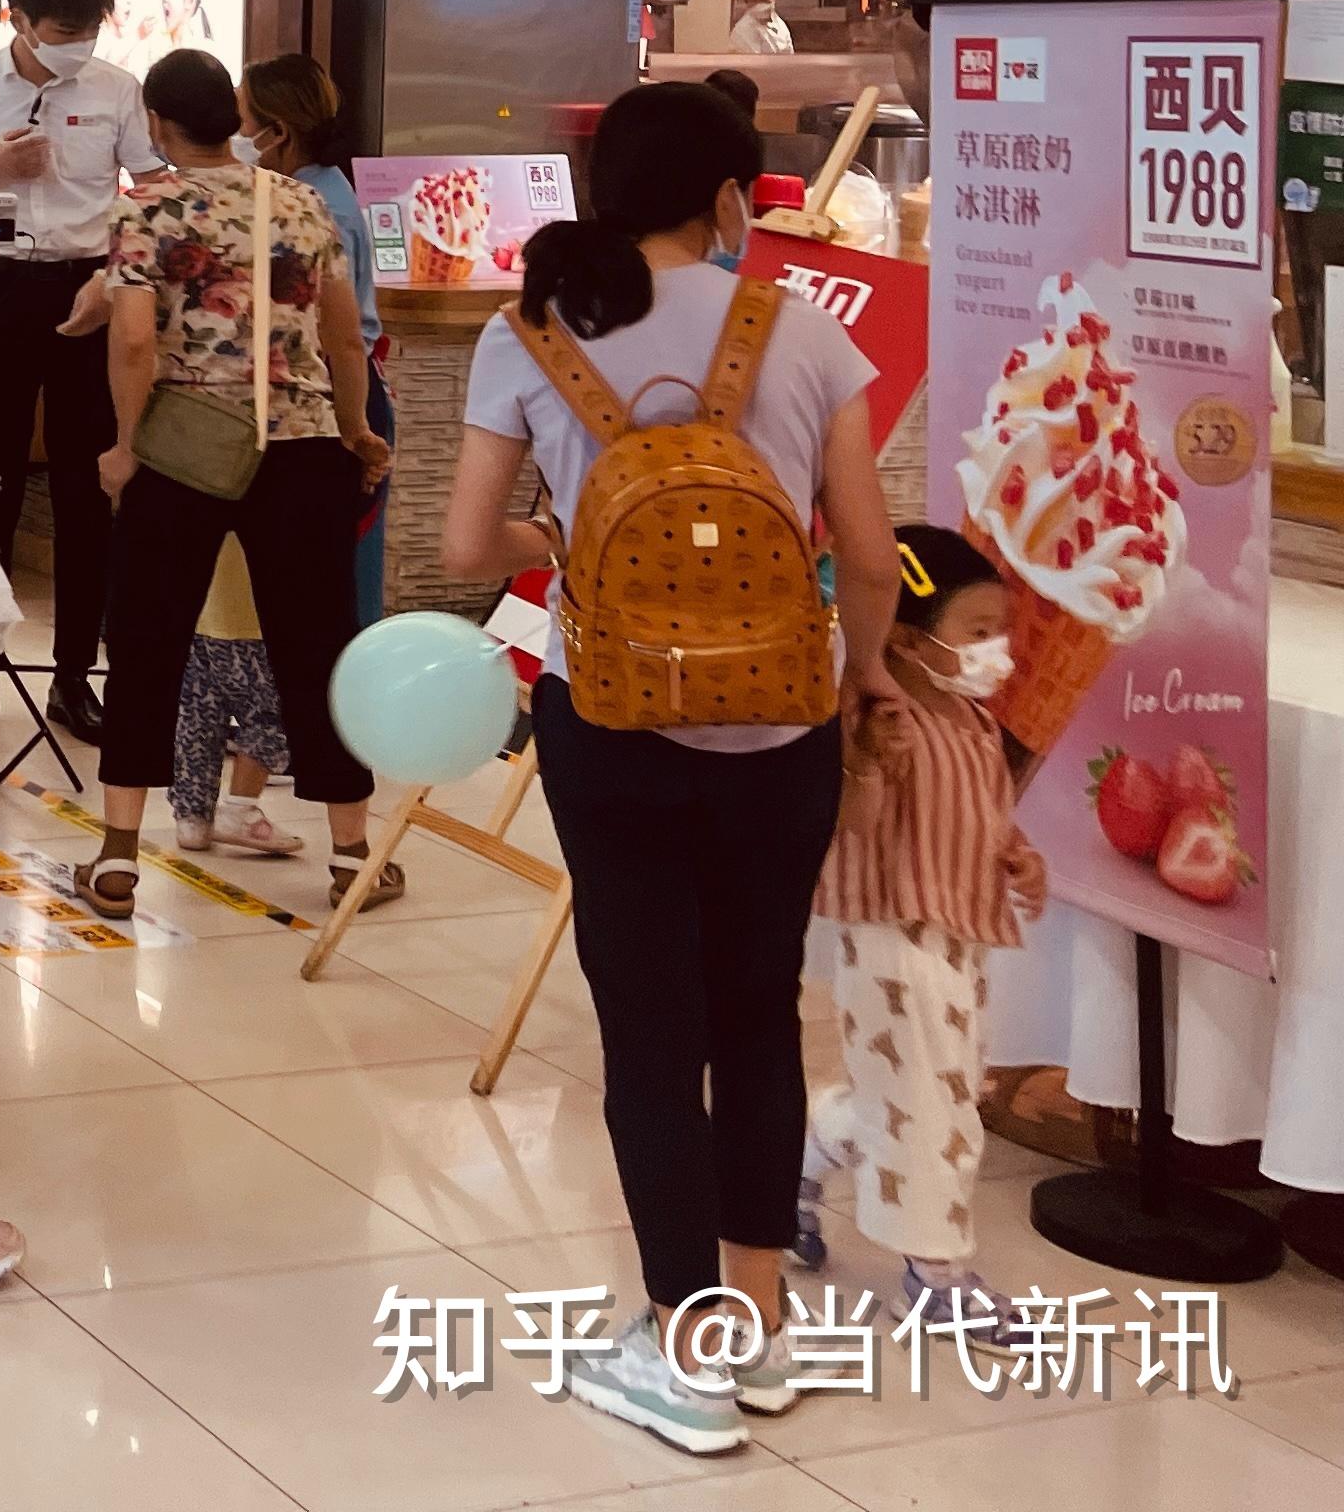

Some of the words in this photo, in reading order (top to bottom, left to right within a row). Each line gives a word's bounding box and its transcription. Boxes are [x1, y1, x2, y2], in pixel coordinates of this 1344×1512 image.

[1143, 54, 1248, 136] 西贝
[529, 165, 555, 183] 西贝
[955, 130, 1072, 175] 草原酸奶
[531, 185, 558, 203] 1988
[955, 183, 1042, 228] 冰淇淋
[1140, 147, 1248, 230] 1988
[1160, 667, 1244, 715] Cream
